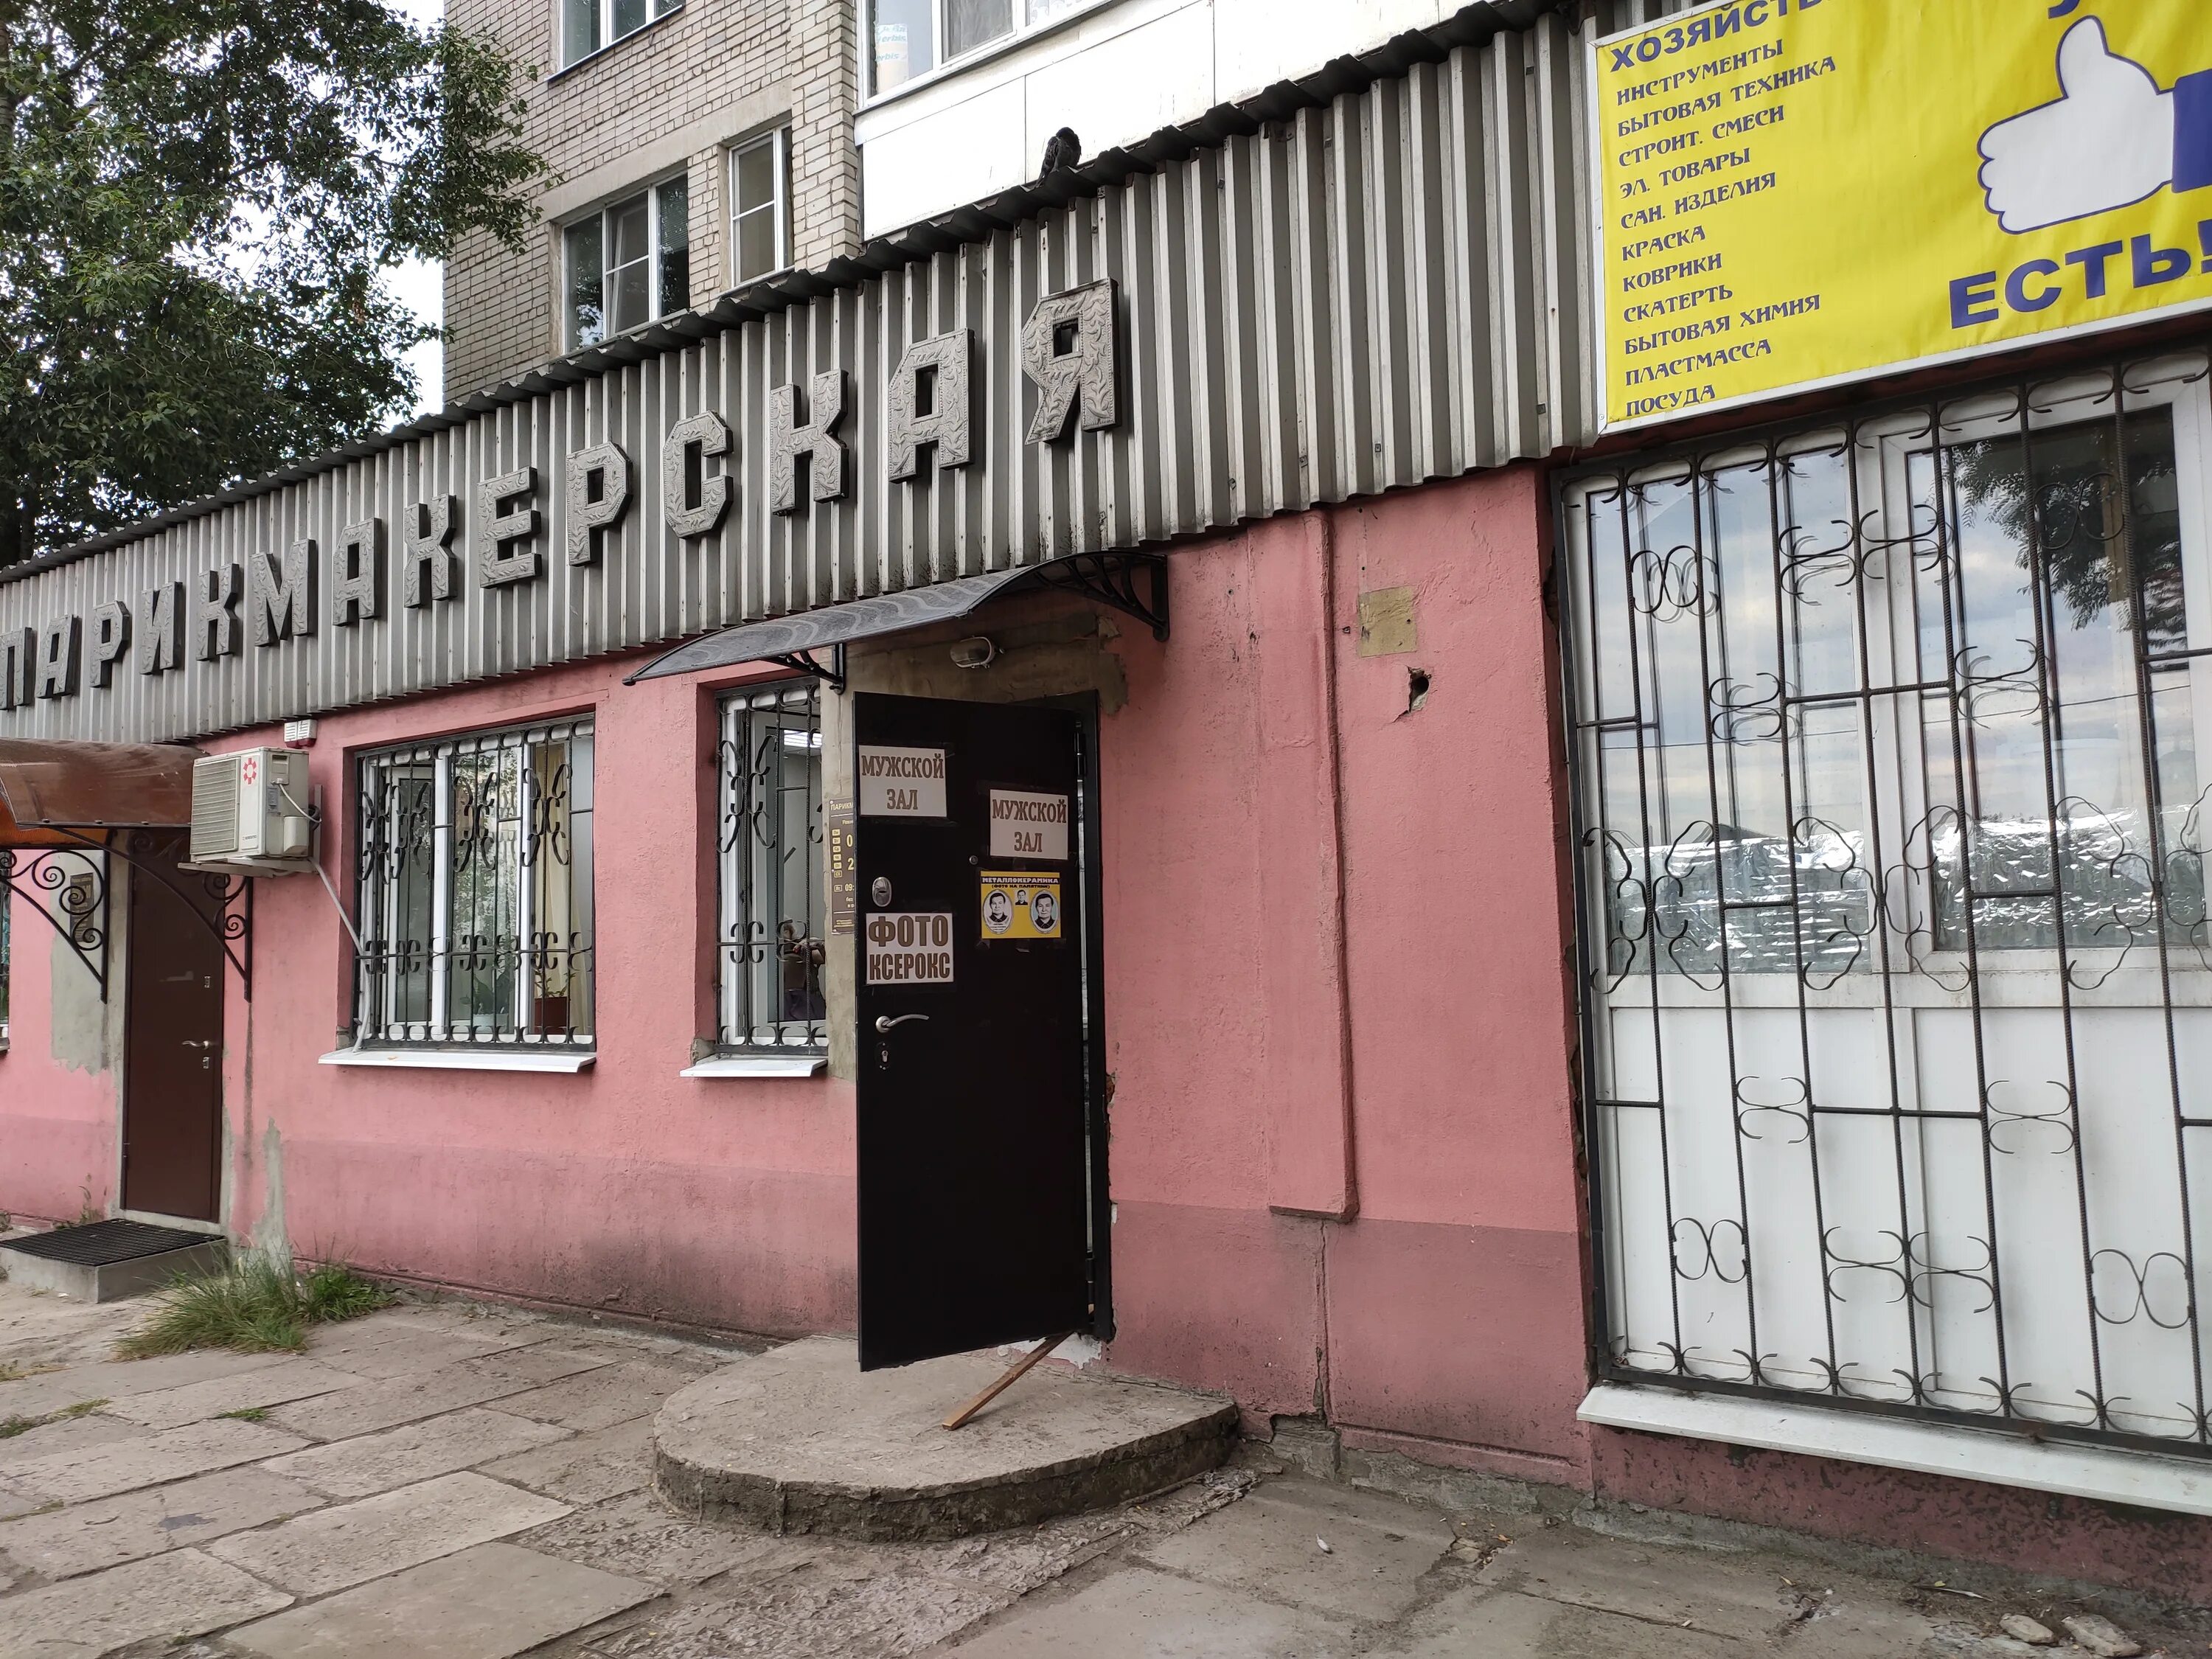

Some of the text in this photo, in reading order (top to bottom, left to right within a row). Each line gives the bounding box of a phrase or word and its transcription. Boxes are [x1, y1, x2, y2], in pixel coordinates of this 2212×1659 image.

[1617, 39, 1783, 105] ИНСТРУМЕНТЫ
[1618, 56, 1836, 137] БЫТОВАЯ ТЕХНИКА
[1618, 105, 1784, 167] СТРОИТ. СМЕСИ
[1620, 147, 1750, 199] ЭЛ. ТОВАРЫ
[1621, 172, 1776, 229] САН. ИЗДЕЛИЯ
[1622, 225, 1705, 261] КРАСКА
[1623, 253, 1722, 292] КОВРИКИ
[1949, 219, 2212, 329] ЕСТЬ!
[1624, 285, 1733, 323] СКАТЕРТЬ
[1624, 294, 1820, 355] БЫТОВАЯ ХИМИЯ
[1625, 339, 1771, 386] ПЛАСТМАССА
[1627, 384, 1716, 417] ПОСУДА
[0, 277, 1120, 710] ПАРИКМАХЕРСКАЯ
[861, 753, 944, 779] МУЖСКОЙ
[886, 788, 919, 810] ЗАЛ
[992, 799, 1066, 823] МУЖСКОЙ
[1014, 831, 1043, 852] ЗАЛ
[869, 915, 949, 947] ФОТО
[869, 952, 950, 980] КСЕРОКС
